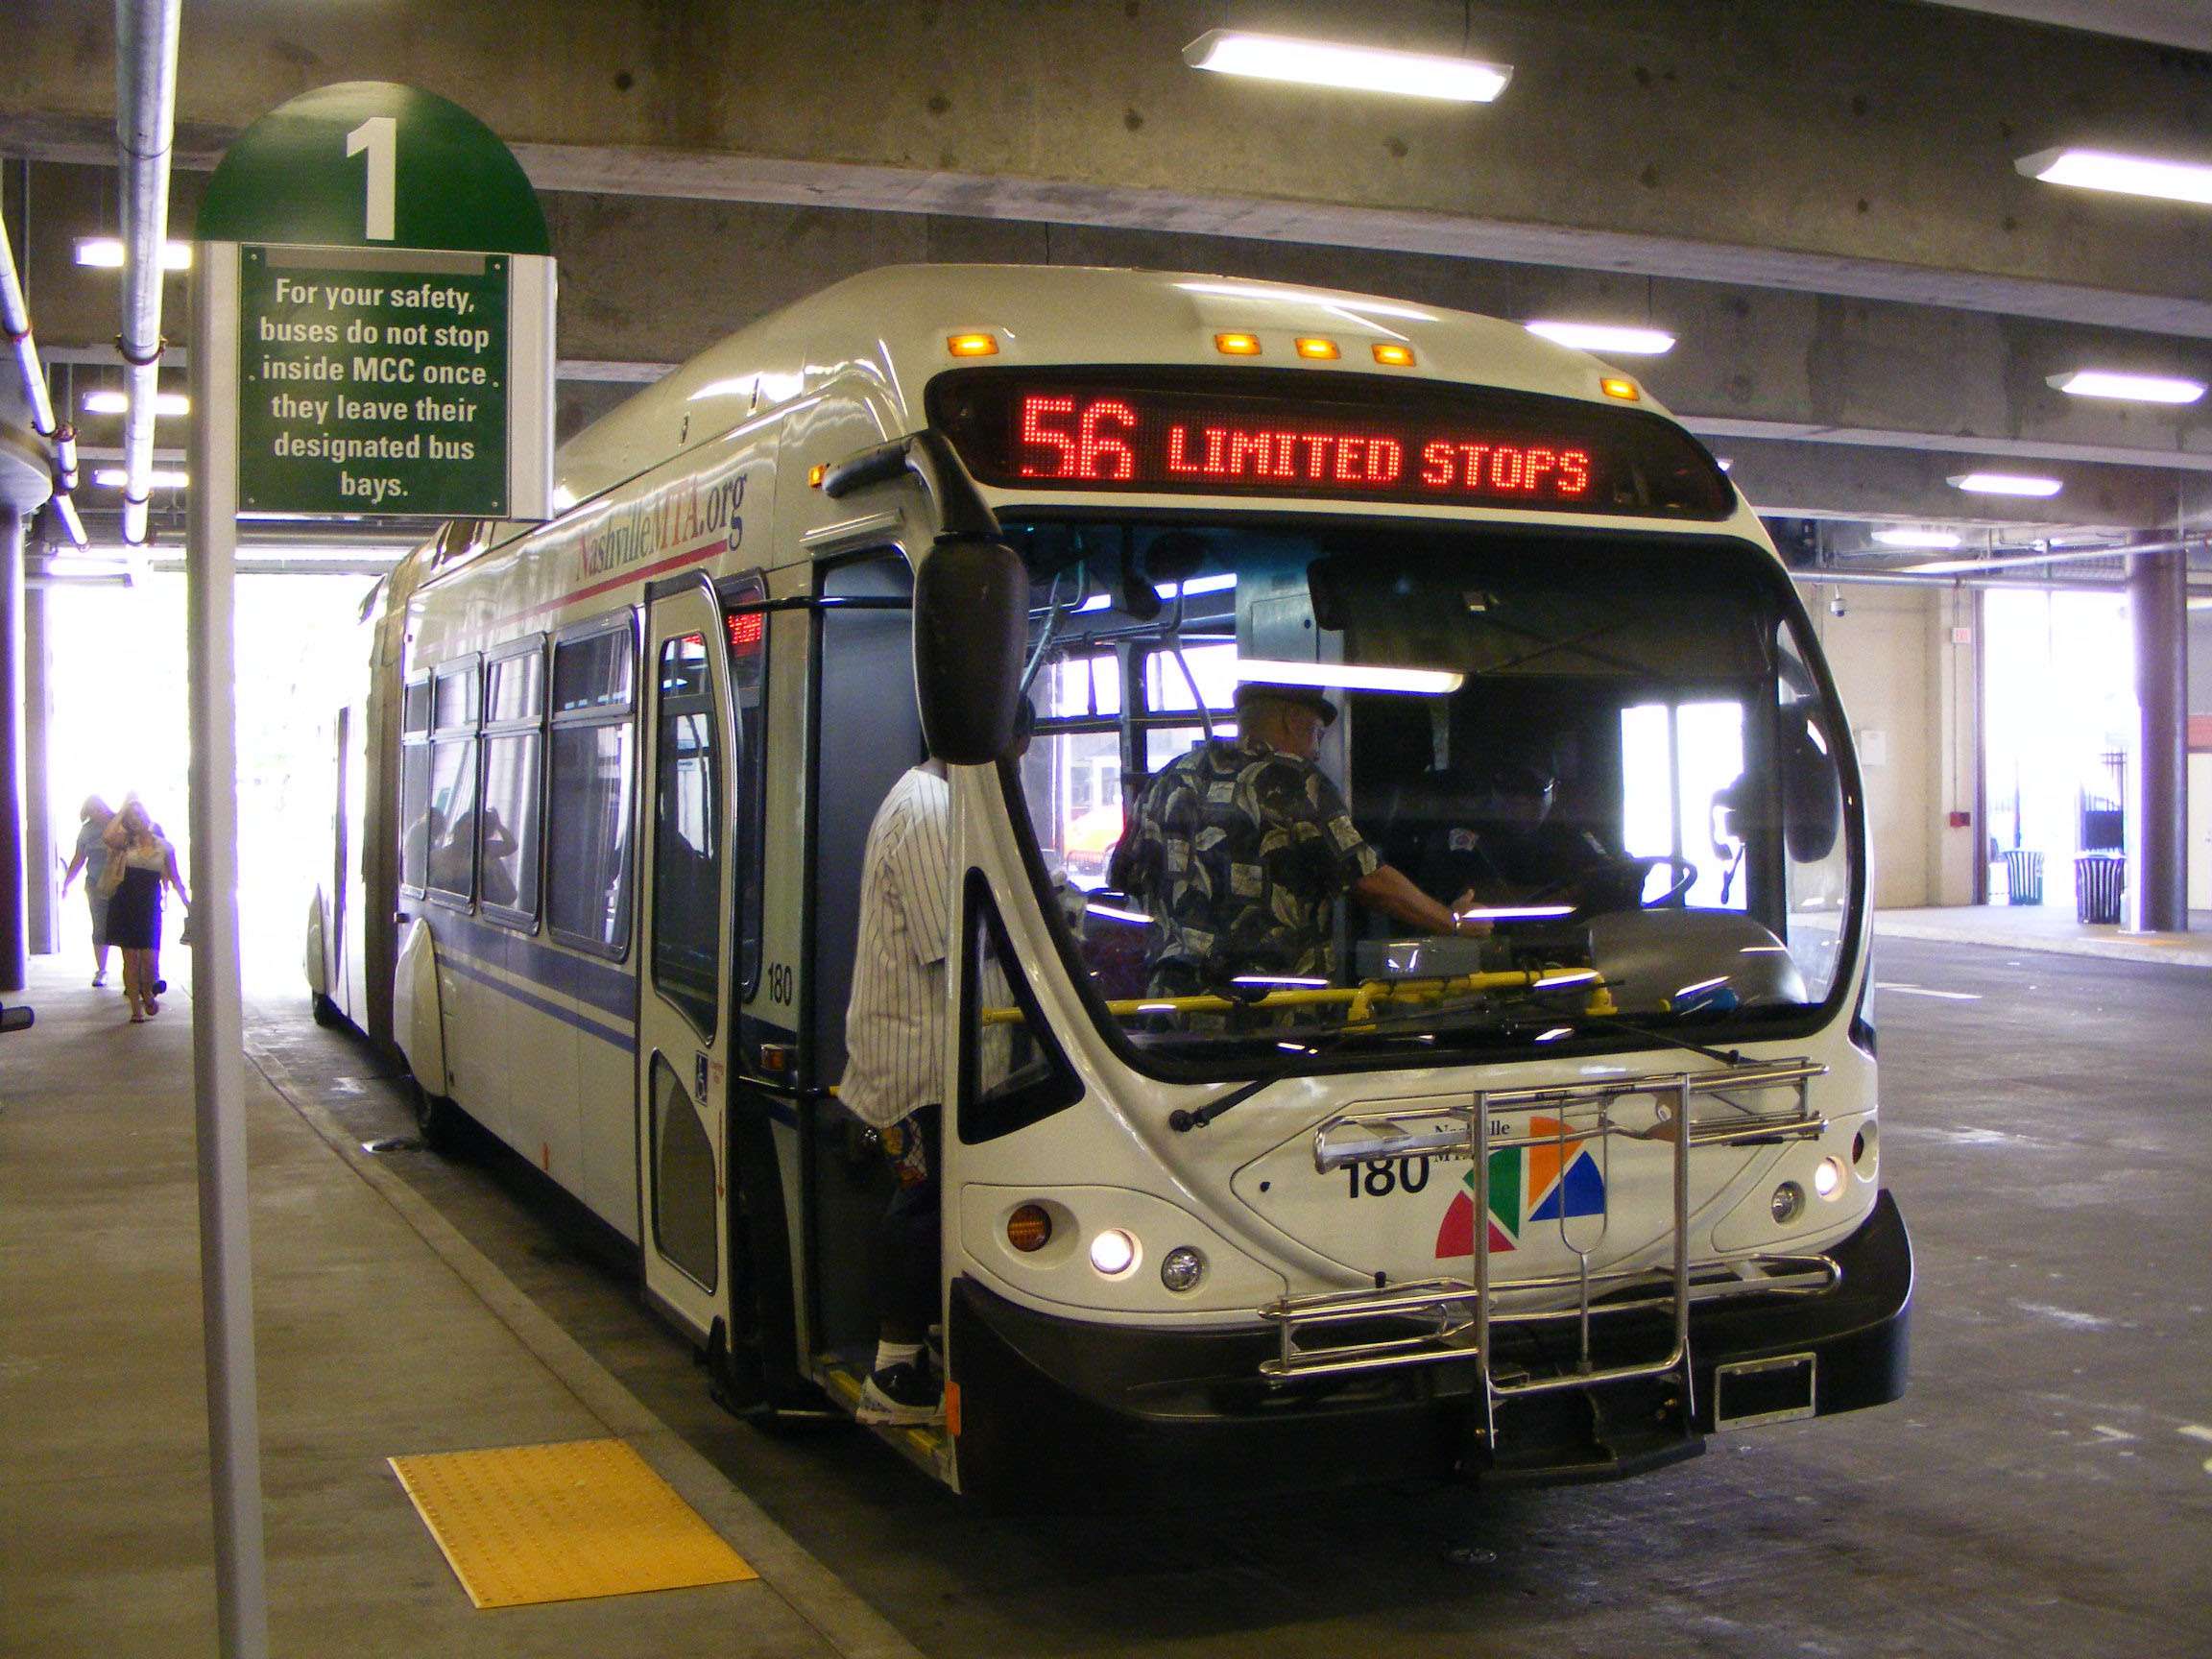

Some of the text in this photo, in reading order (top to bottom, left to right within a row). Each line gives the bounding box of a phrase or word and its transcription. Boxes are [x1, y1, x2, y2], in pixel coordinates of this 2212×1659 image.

[347, 116, 397, 240] 1
[276, 278, 475, 315] For your safety,
[260, 317, 490, 353] buses do not stop
[263, 354, 487, 385] inside MCC once
[272, 394, 477, 424] they leave their
[274, 433, 475, 464] designated bus
[1021, 397, 1590, 493] 56 LIMITED STOPS
[341, 471, 409, 503] bays.
[768, 963, 793, 1006] 180
[1339, 1157, 1430, 1198] 180
